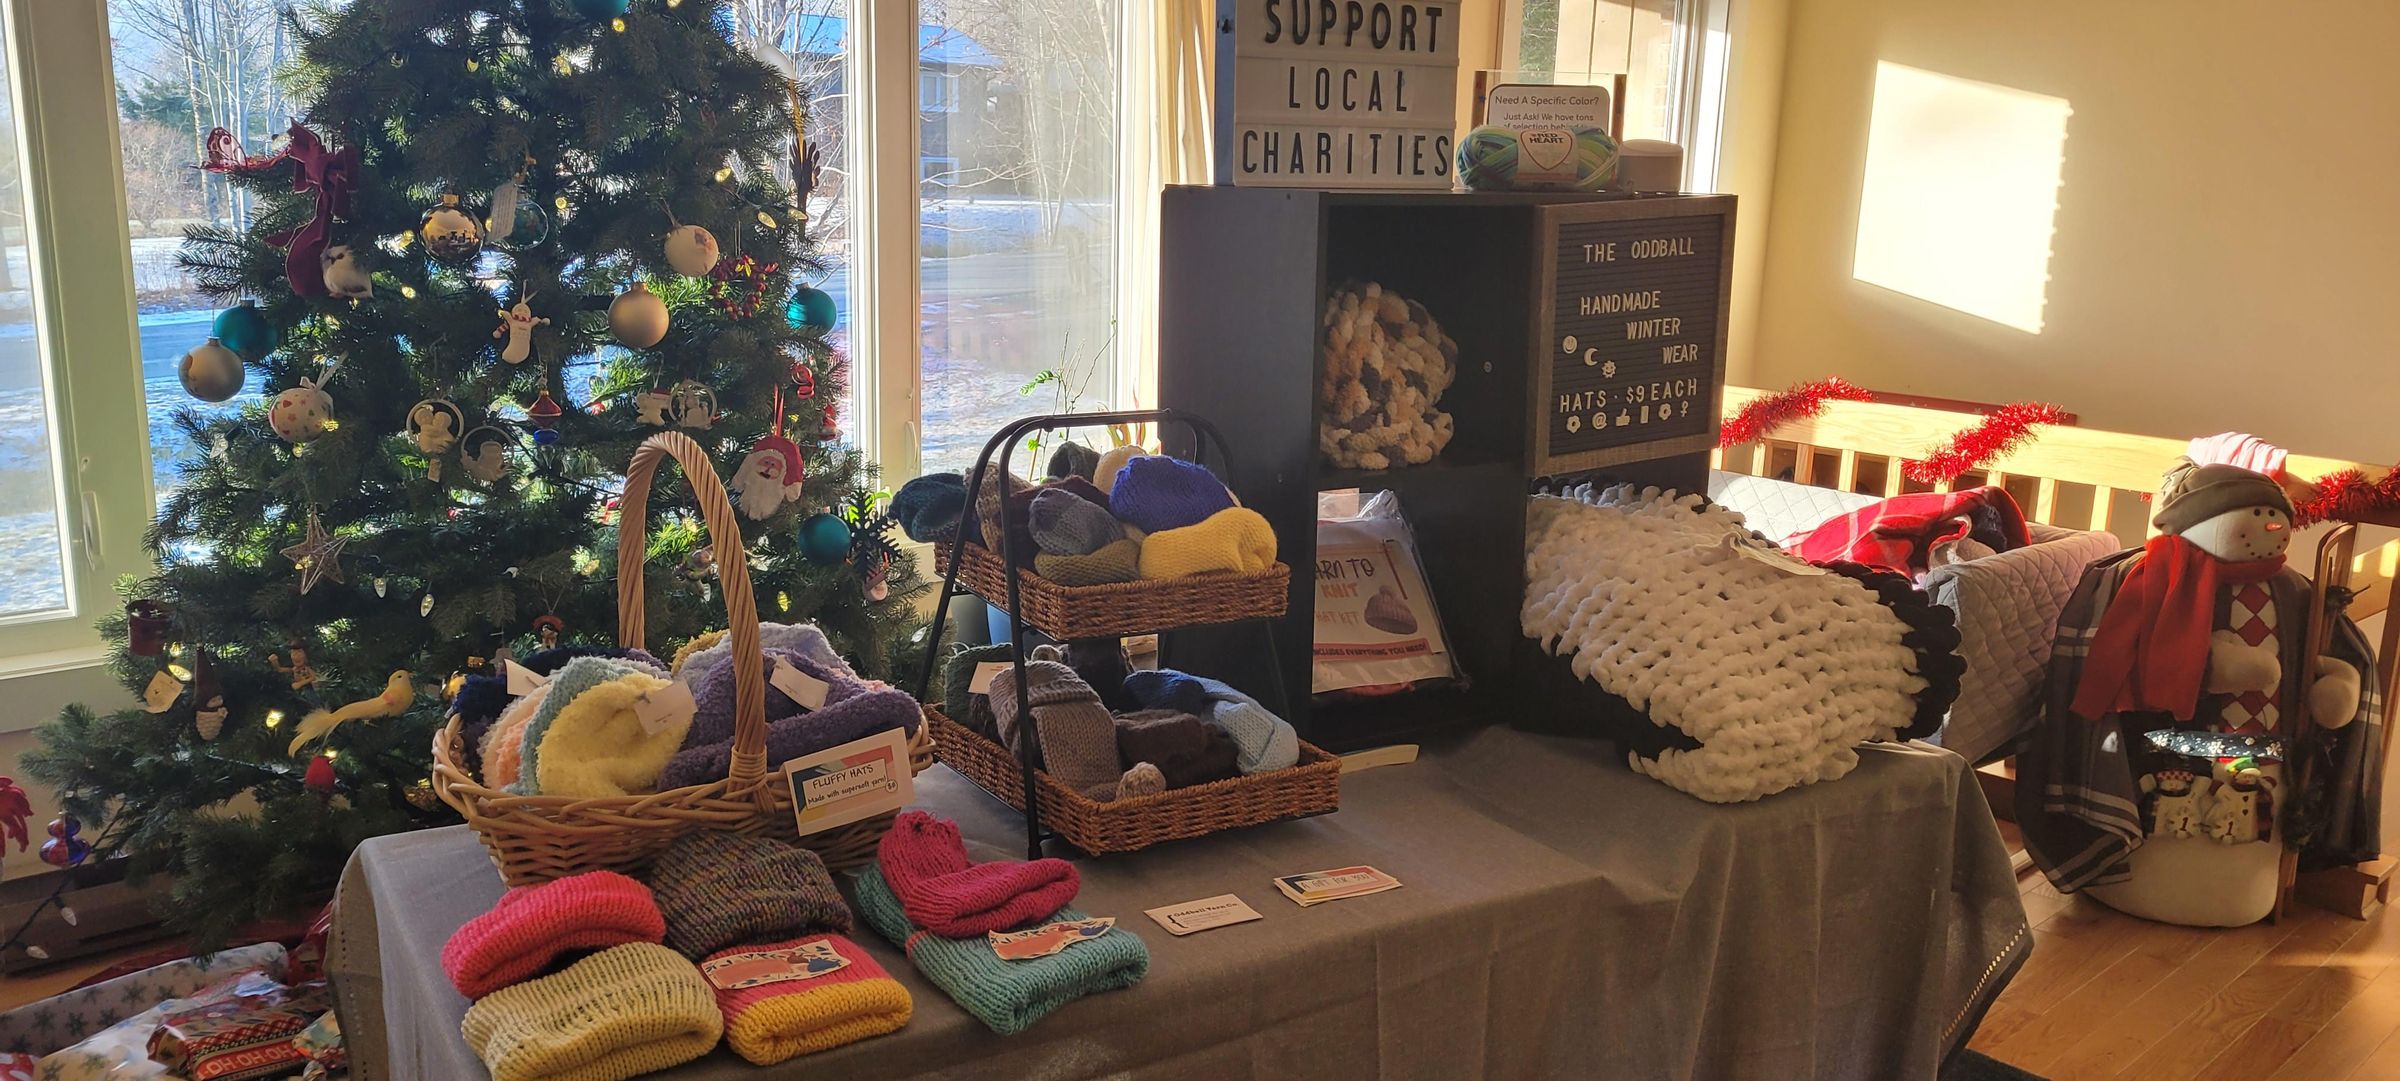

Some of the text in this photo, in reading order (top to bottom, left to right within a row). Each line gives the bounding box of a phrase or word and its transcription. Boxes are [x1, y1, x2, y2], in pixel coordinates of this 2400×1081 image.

[1265, 0, 1443, 53] SUPPORT
[1289, 66, 1407, 112] LOCAL
[1495, 95, 1600, 107] Need A Specific Color?
[1503, 113, 1594, 121] Just Ask! We have tons
[1242, 130, 1449, 177] CHARITIES
[1583, 243, 1617, 263] THE
[1631, 237, 1695, 259] ODDBALL
[1580, 290, 1661, 316] HANDMADE
[1626, 317, 1681, 340] WINTER
[1663, 343, 1698, 364] WEAR
[1559, 390, 1607, 413] HATS
[1345, 558, 1375, 578] TO
[1320, 582, 1359, 599] KNIT
[1389, 646, 1405, 655] YOU
[813, 765, 874, 789] FLUFFY HATS
[807, 776, 886, 804] Made with supersoft yarn!
